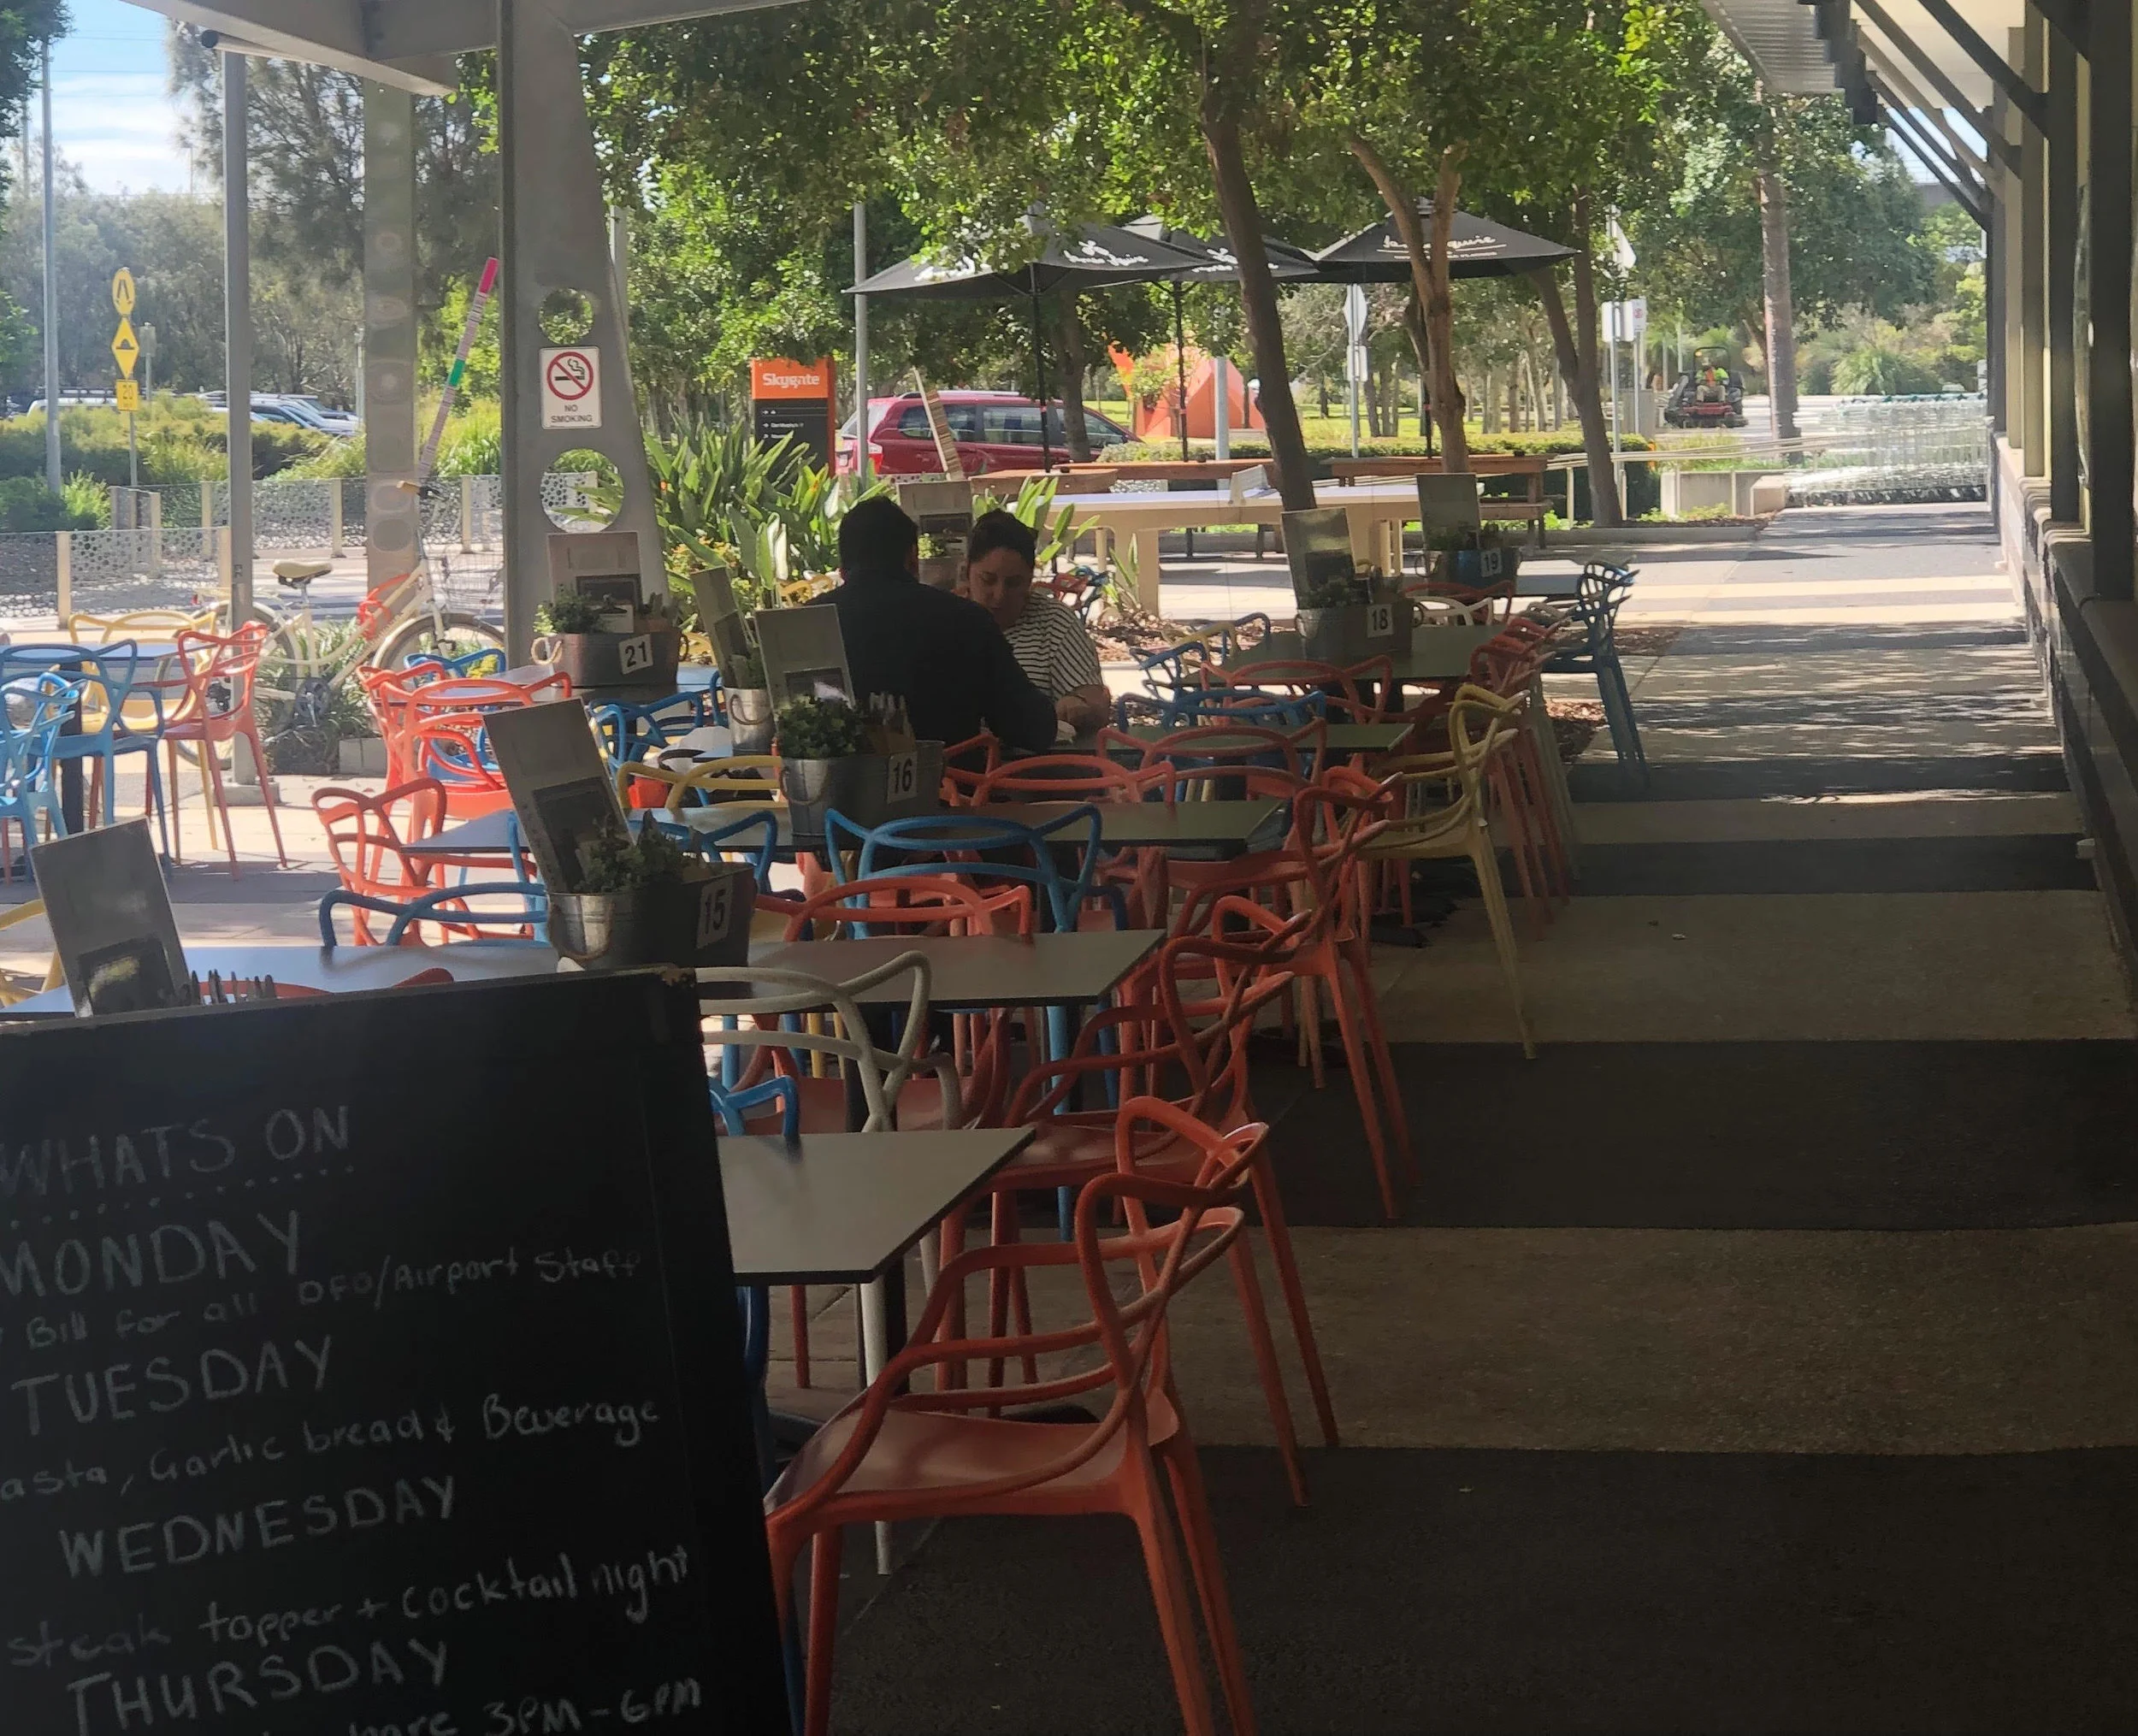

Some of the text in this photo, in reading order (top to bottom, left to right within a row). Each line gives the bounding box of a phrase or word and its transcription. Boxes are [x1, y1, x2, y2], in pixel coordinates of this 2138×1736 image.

[762, 373, 820, 388] Skygate
[551, 415, 593, 423] SMOKING
[564, 404, 578, 412] NO
[1484, 551, 1498, 573] 19
[1372, 608, 1388, 631] 18
[625, 641, 647, 668] 21
[894, 758, 912, 794] 16
[704, 889, 726, 935] 15
[0, 1105, 349, 1196] WHATS ON
[0, 1209, 299, 1296] MONDAY
[115, 1308, 181, 1340] for
[203, 1292, 257, 1322] all
[10, 1334, 333, 1436] TUESDAY
[0, 1458, 134, 1503] asta,
[303, 1408, 425, 1453] bread
[482, 1392, 660, 1447] Beverage
[58, 1475, 454, 1579] WEDNESDAY
[198, 1601, 343, 1648] topper
[591, 1544, 688, 1624] night
[66, 1638, 447, 1736] THURSDAY
